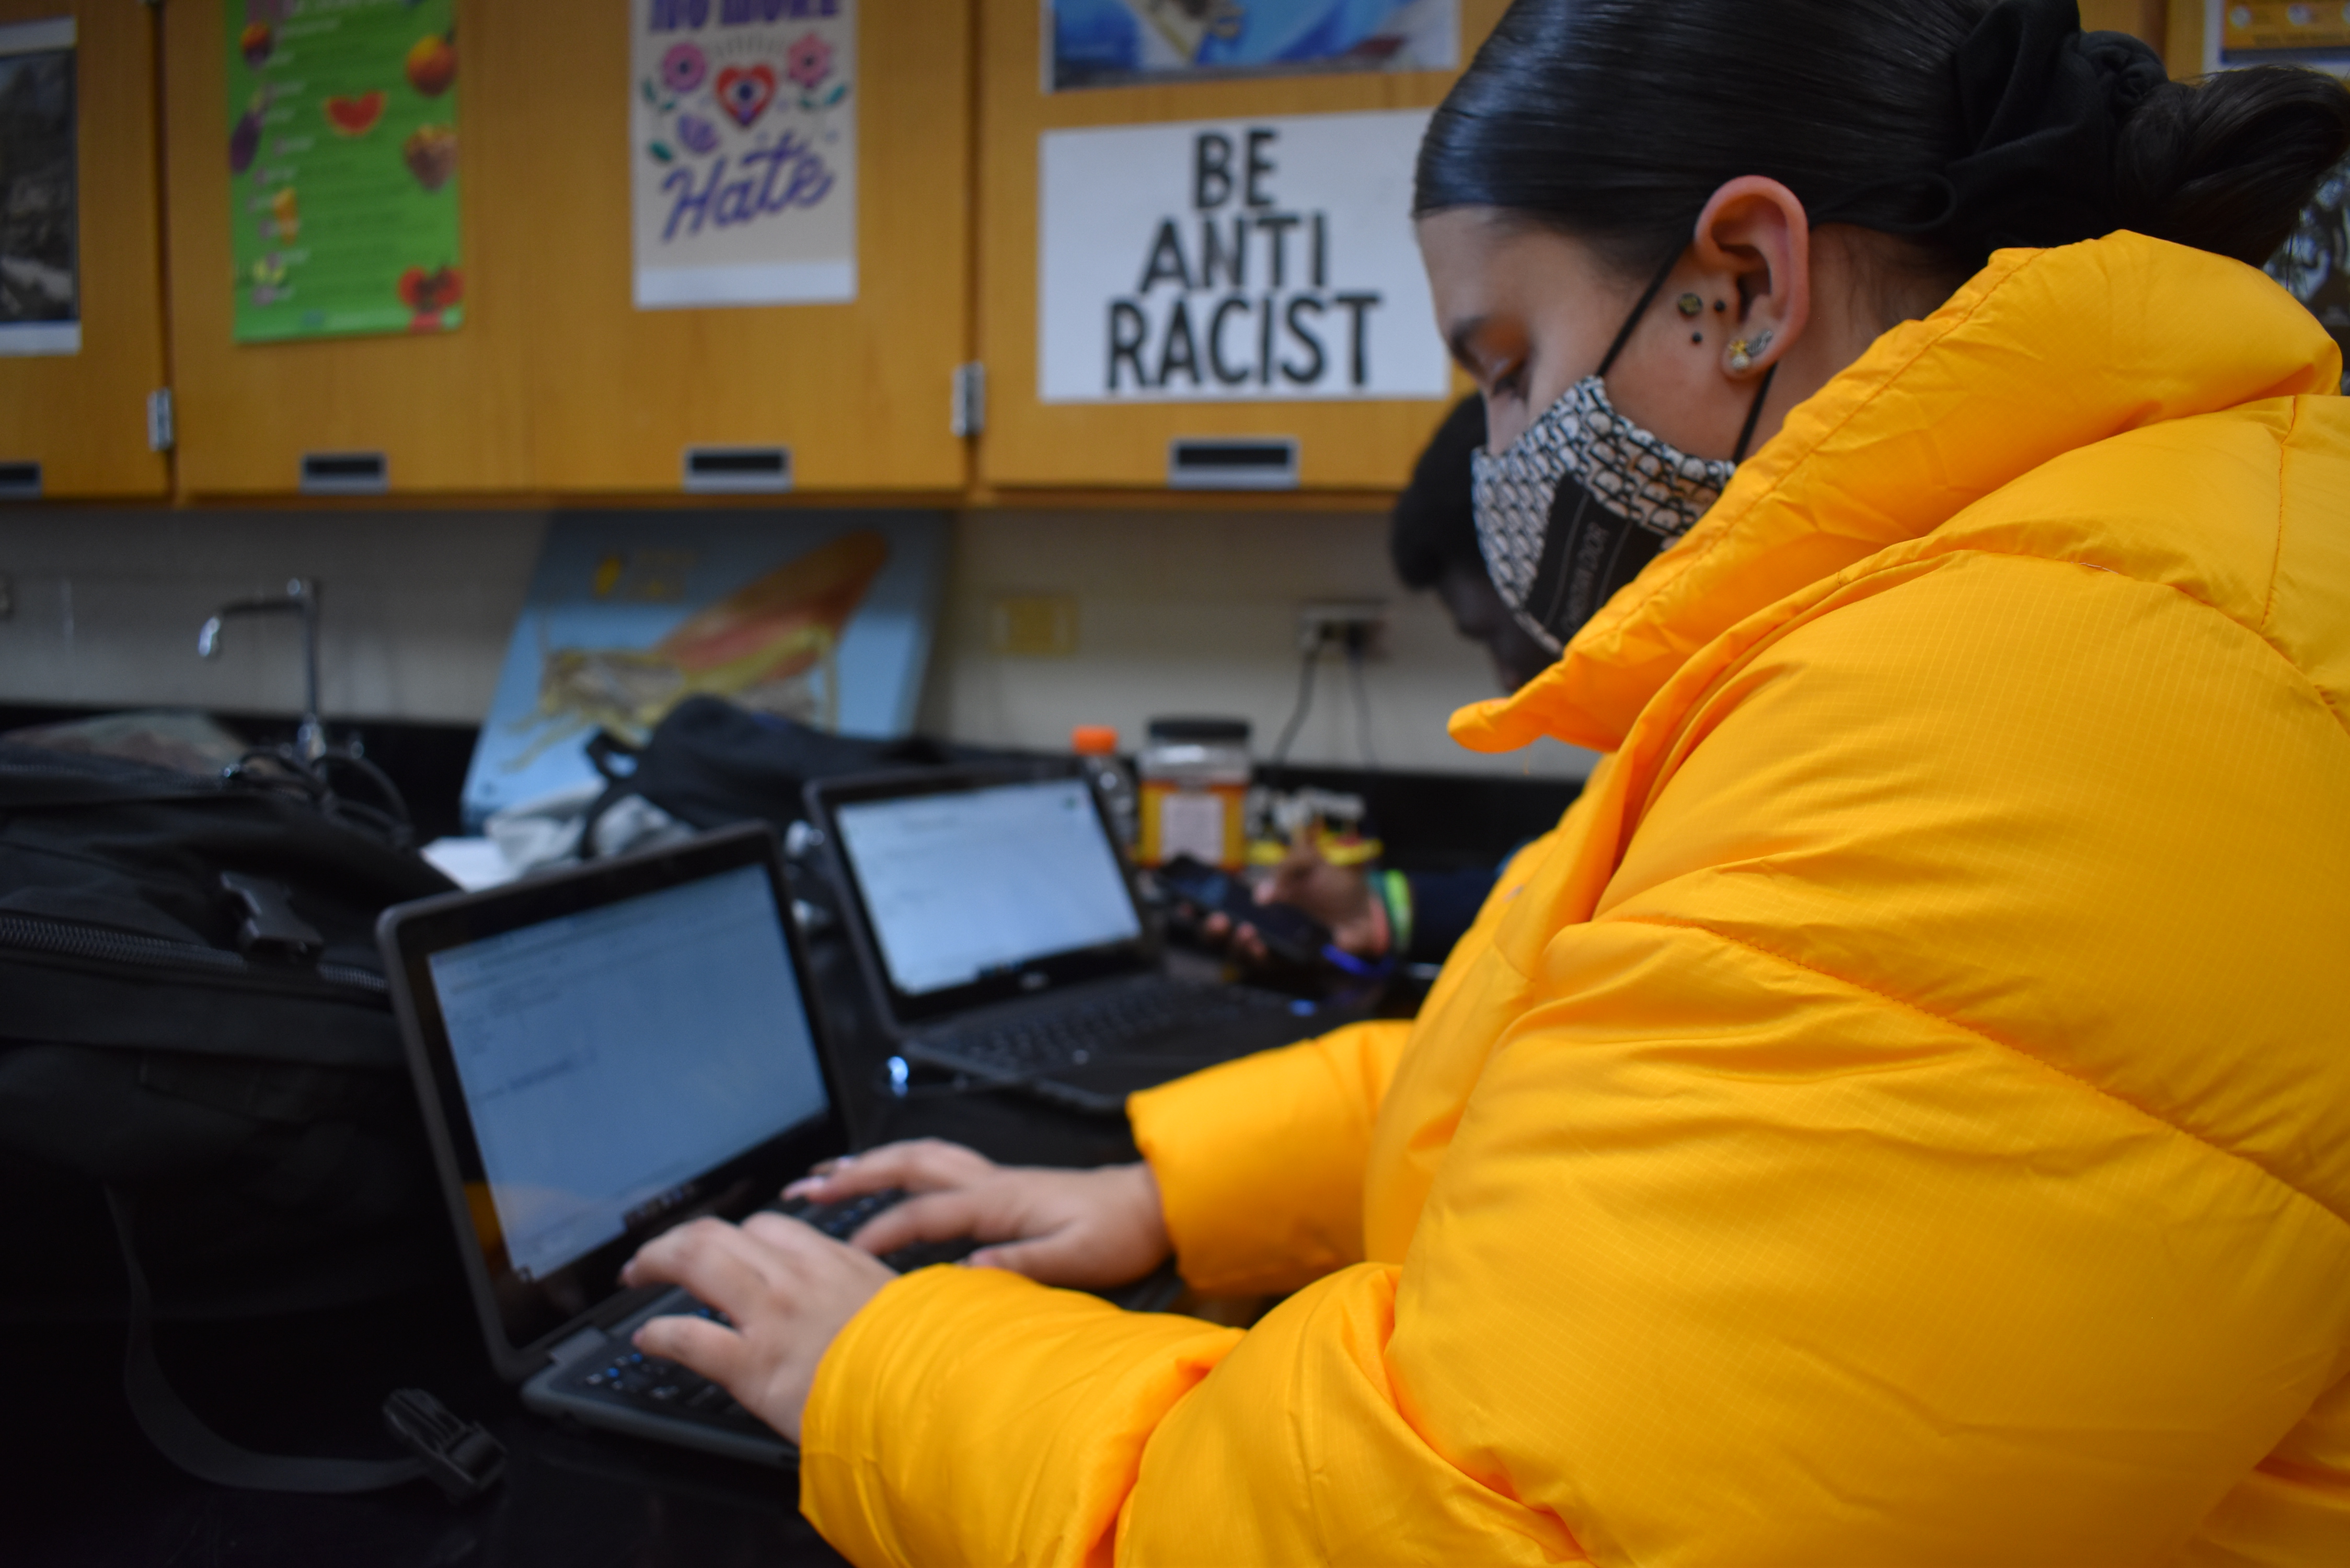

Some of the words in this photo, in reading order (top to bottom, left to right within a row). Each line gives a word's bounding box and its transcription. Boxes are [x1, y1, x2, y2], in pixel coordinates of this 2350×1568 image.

[663, 132, 834, 243] Hate
[1193, 128, 1277, 209] BE
[1139, 213, 1329, 293] ANTI
[1107, 292, 1381, 390] RACIST
